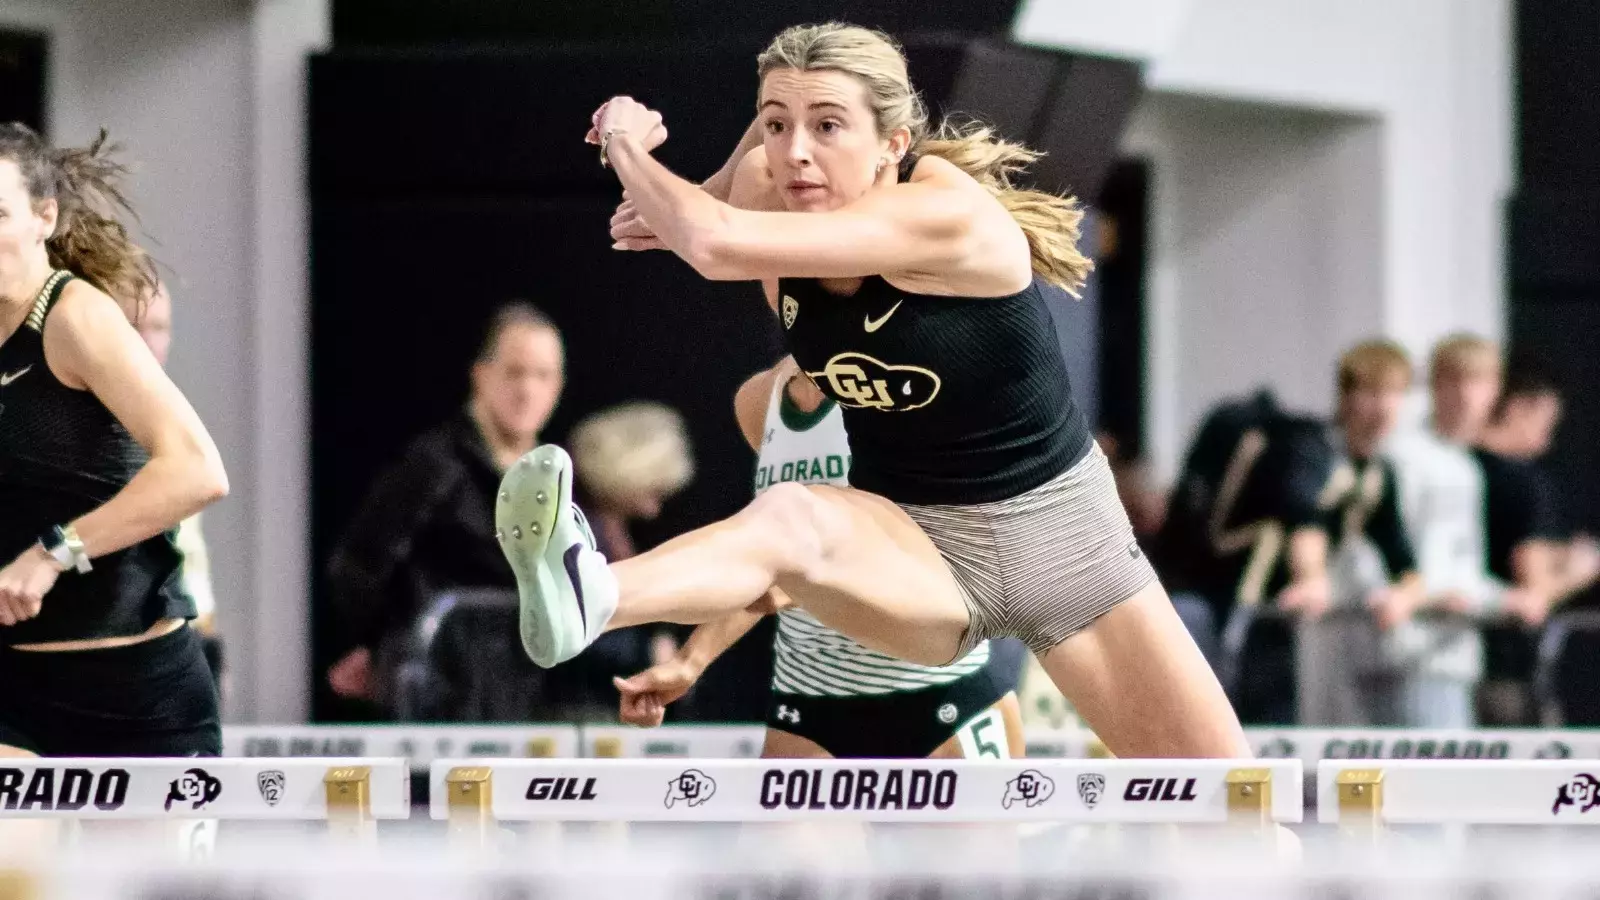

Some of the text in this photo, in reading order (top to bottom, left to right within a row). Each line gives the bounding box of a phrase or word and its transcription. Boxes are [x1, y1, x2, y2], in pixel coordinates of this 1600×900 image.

[970, 716, 1001, 759] 5
[0, 768, 131, 811] RADO
[525, 777, 598, 801] GILL
[759, 769, 958, 810] COLORADO
[1122, 777, 1198, 802] GILL
